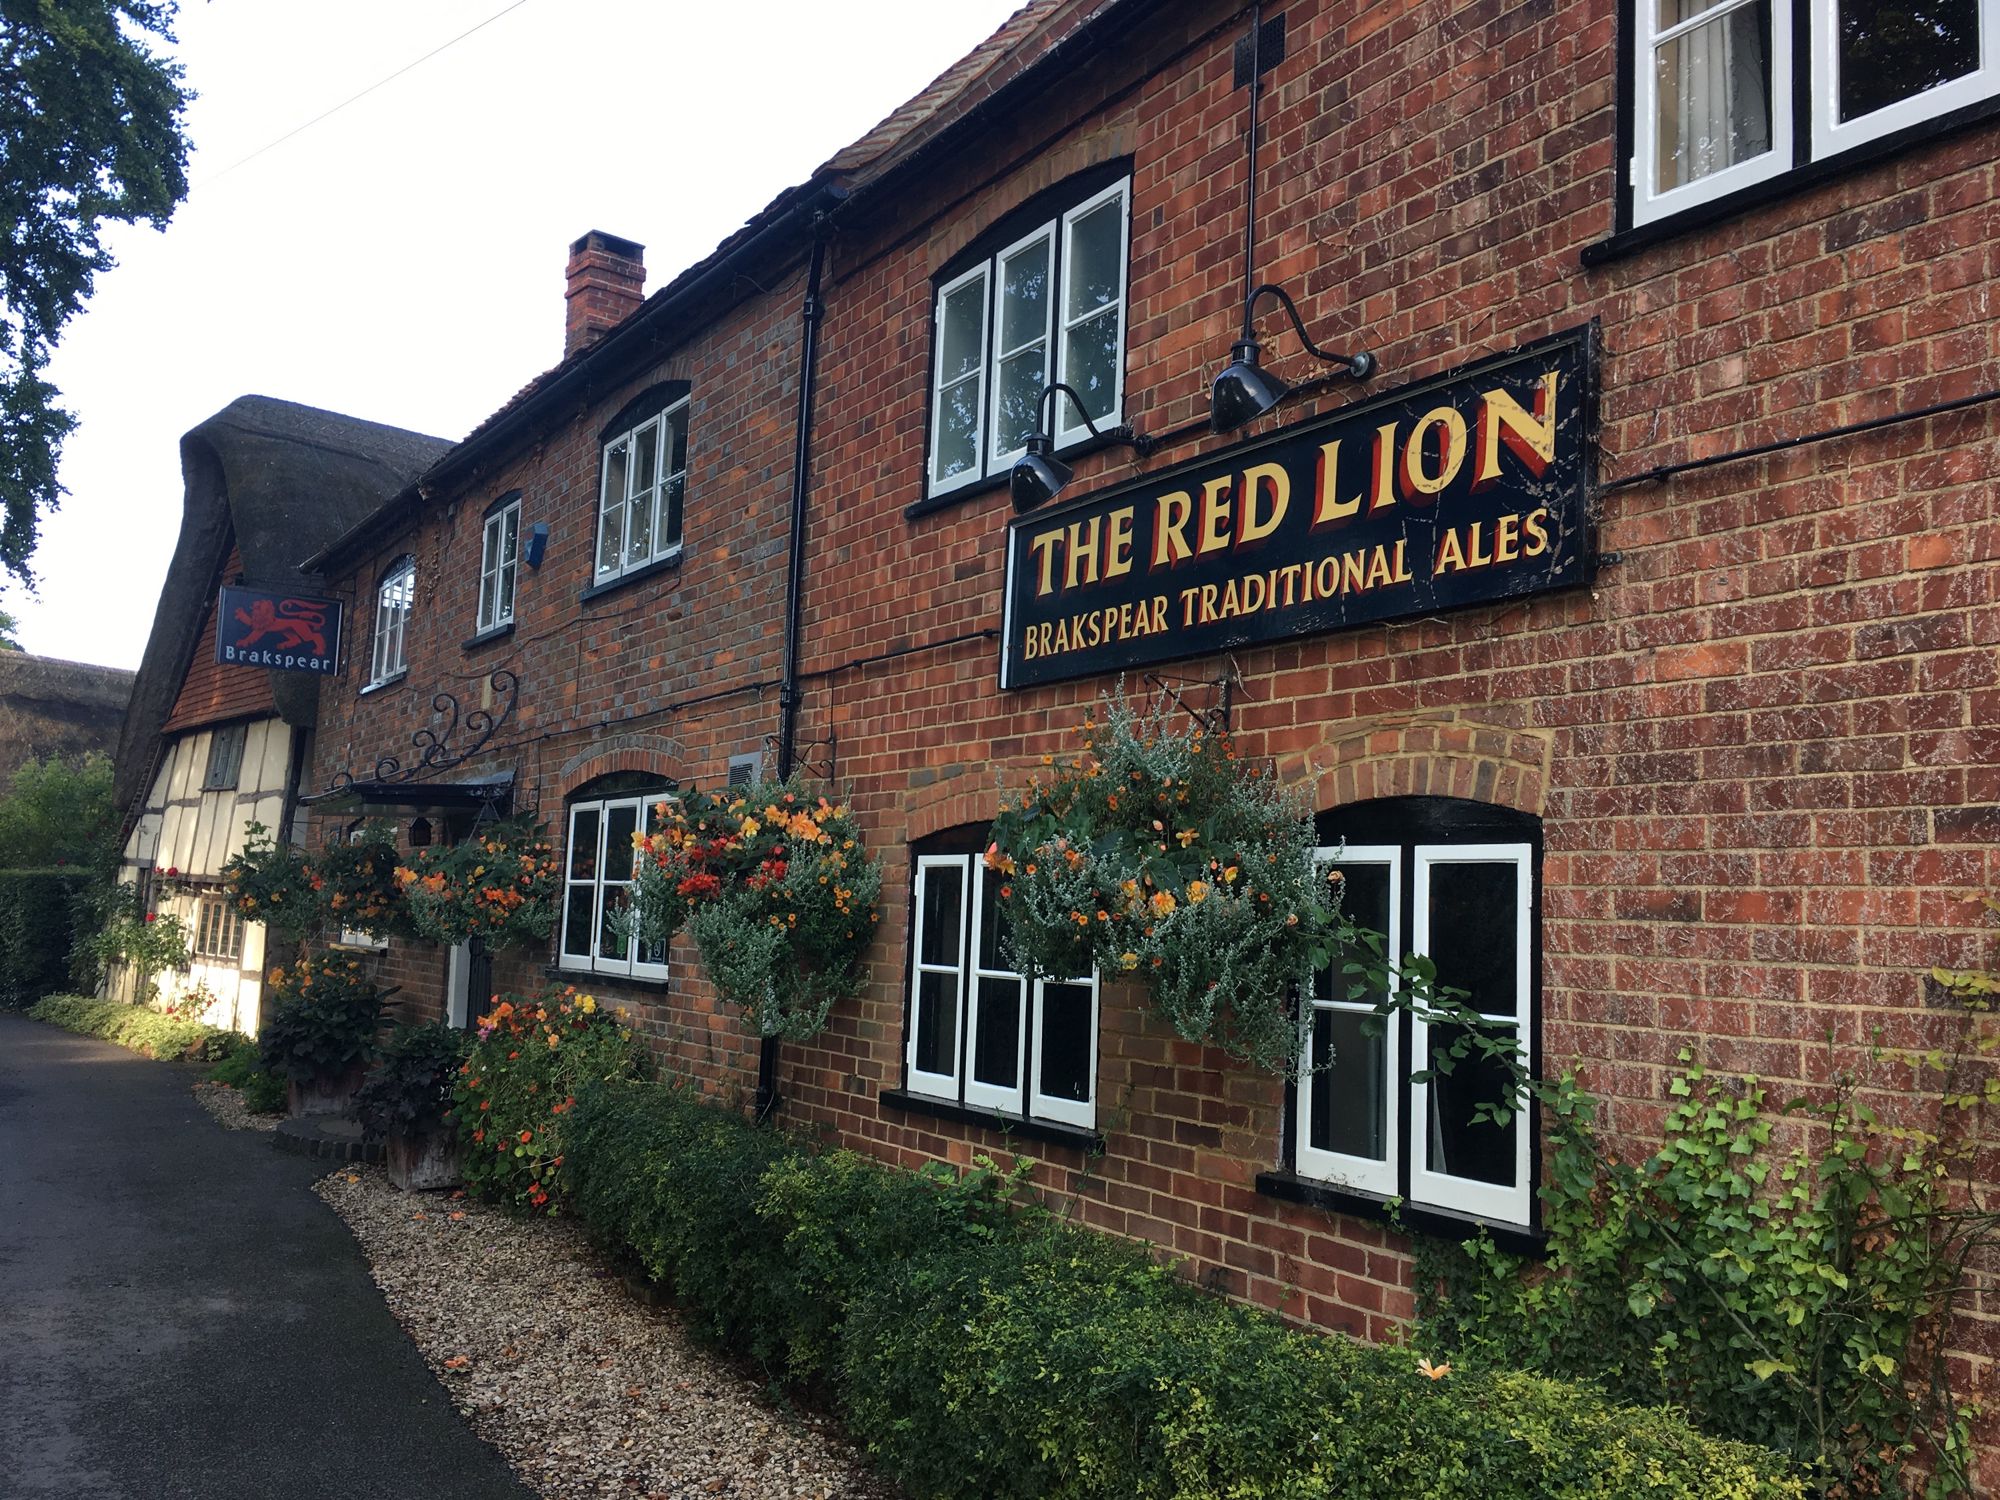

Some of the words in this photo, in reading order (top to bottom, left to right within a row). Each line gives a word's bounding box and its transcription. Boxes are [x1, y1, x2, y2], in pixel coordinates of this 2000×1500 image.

[1030, 505, 1135, 598] THE
[1153, 462, 1292, 568] RED
[1315, 370, 1562, 526] LION
[225, 646, 331, 670] Brakspear
[1024, 596, 1169, 661] BRAKSPEAR
[1181, 539, 1413, 627] TRADITIONAL
[1435, 507, 1549, 576] ALES
